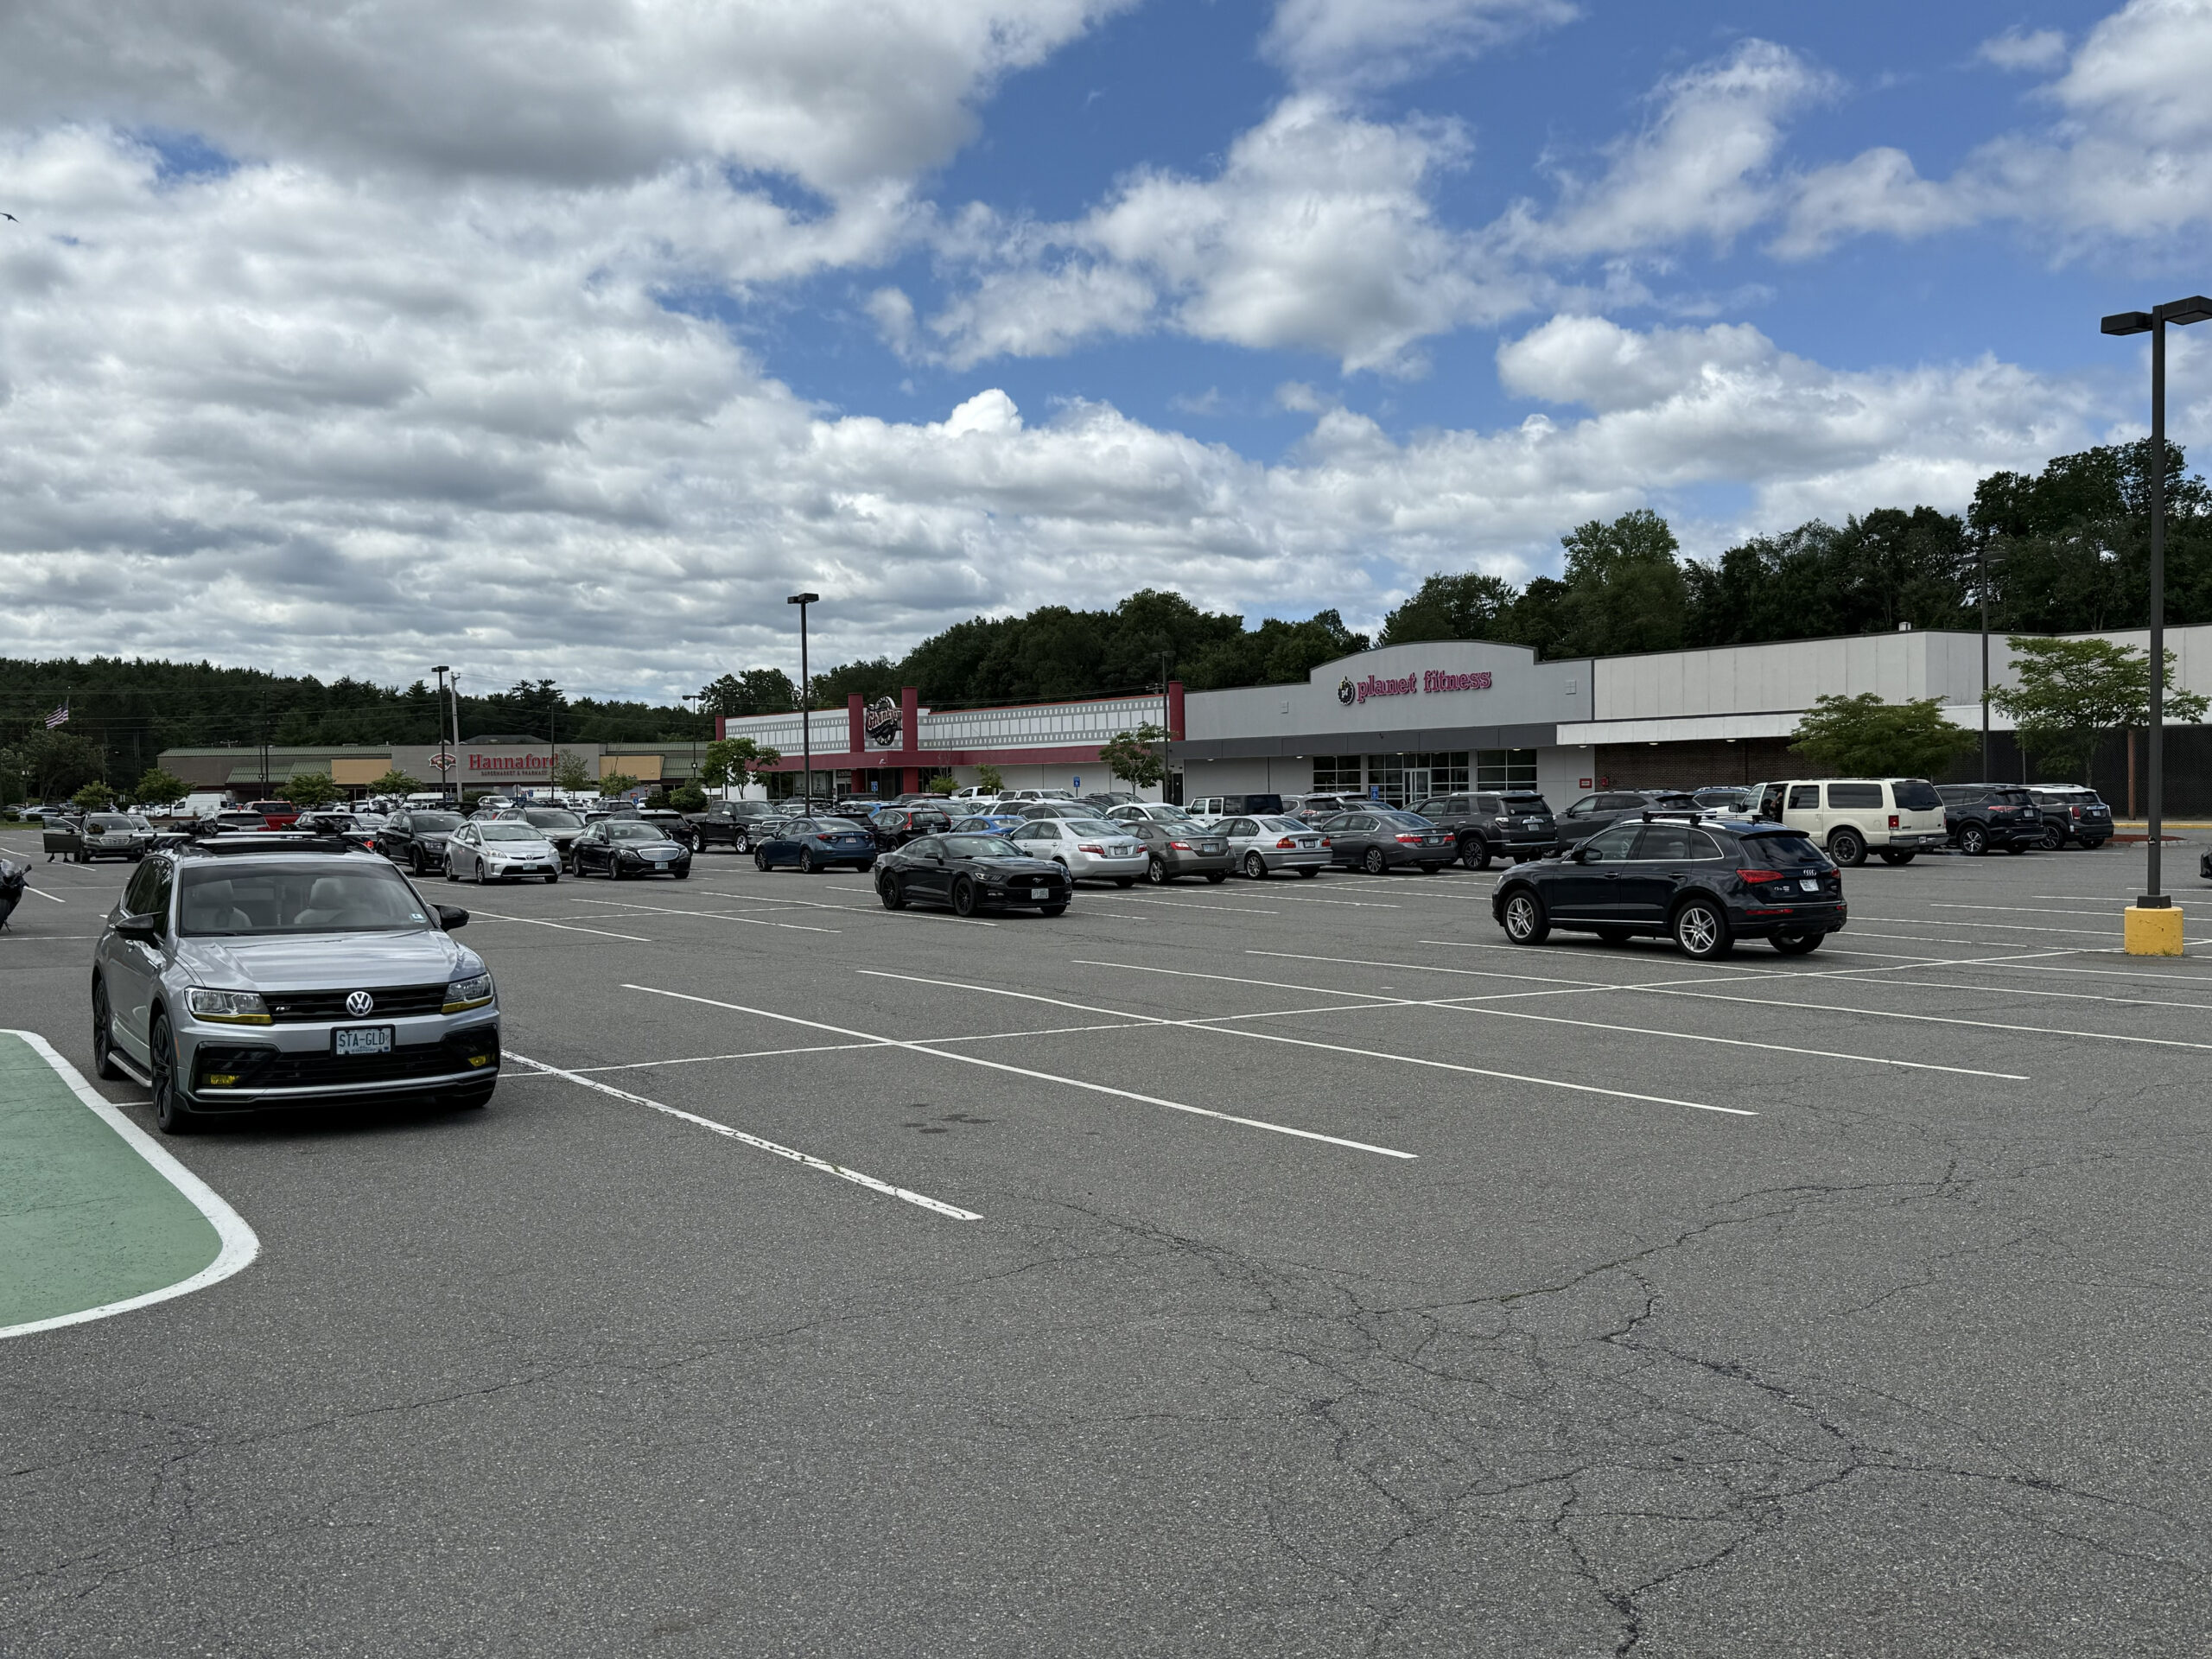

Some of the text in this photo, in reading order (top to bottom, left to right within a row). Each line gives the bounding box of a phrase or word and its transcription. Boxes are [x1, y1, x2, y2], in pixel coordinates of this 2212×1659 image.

[1357, 670, 1491, 703] planet fitness
[467, 753, 560, 770] Hannaford
[338, 1032, 385, 1047] STA-GLD
